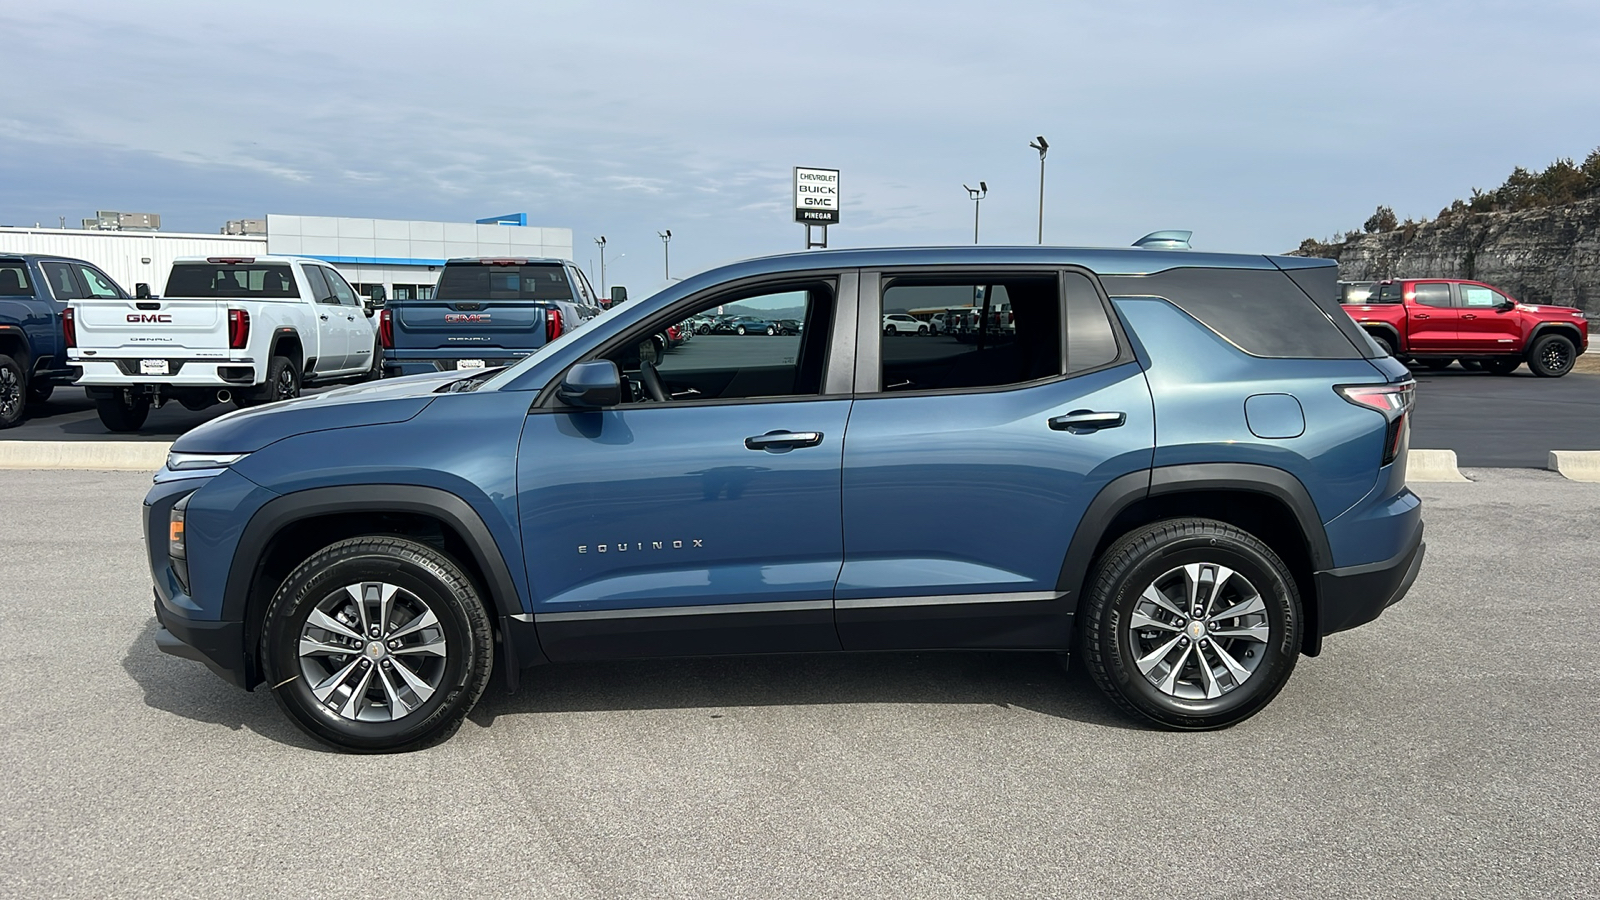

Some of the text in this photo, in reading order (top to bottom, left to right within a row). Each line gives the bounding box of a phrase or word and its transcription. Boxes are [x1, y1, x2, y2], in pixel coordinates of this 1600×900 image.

[800, 173, 836, 182] CHEVROLET
[799, 185, 836, 194] BUICK
[804, 197, 832, 206] GMC
[804, 212, 832, 220] PINEGAR
[126, 314, 172, 323] GMC
[445, 313, 491, 323] GMC
[578, 539, 703, 554] EQUINOX
